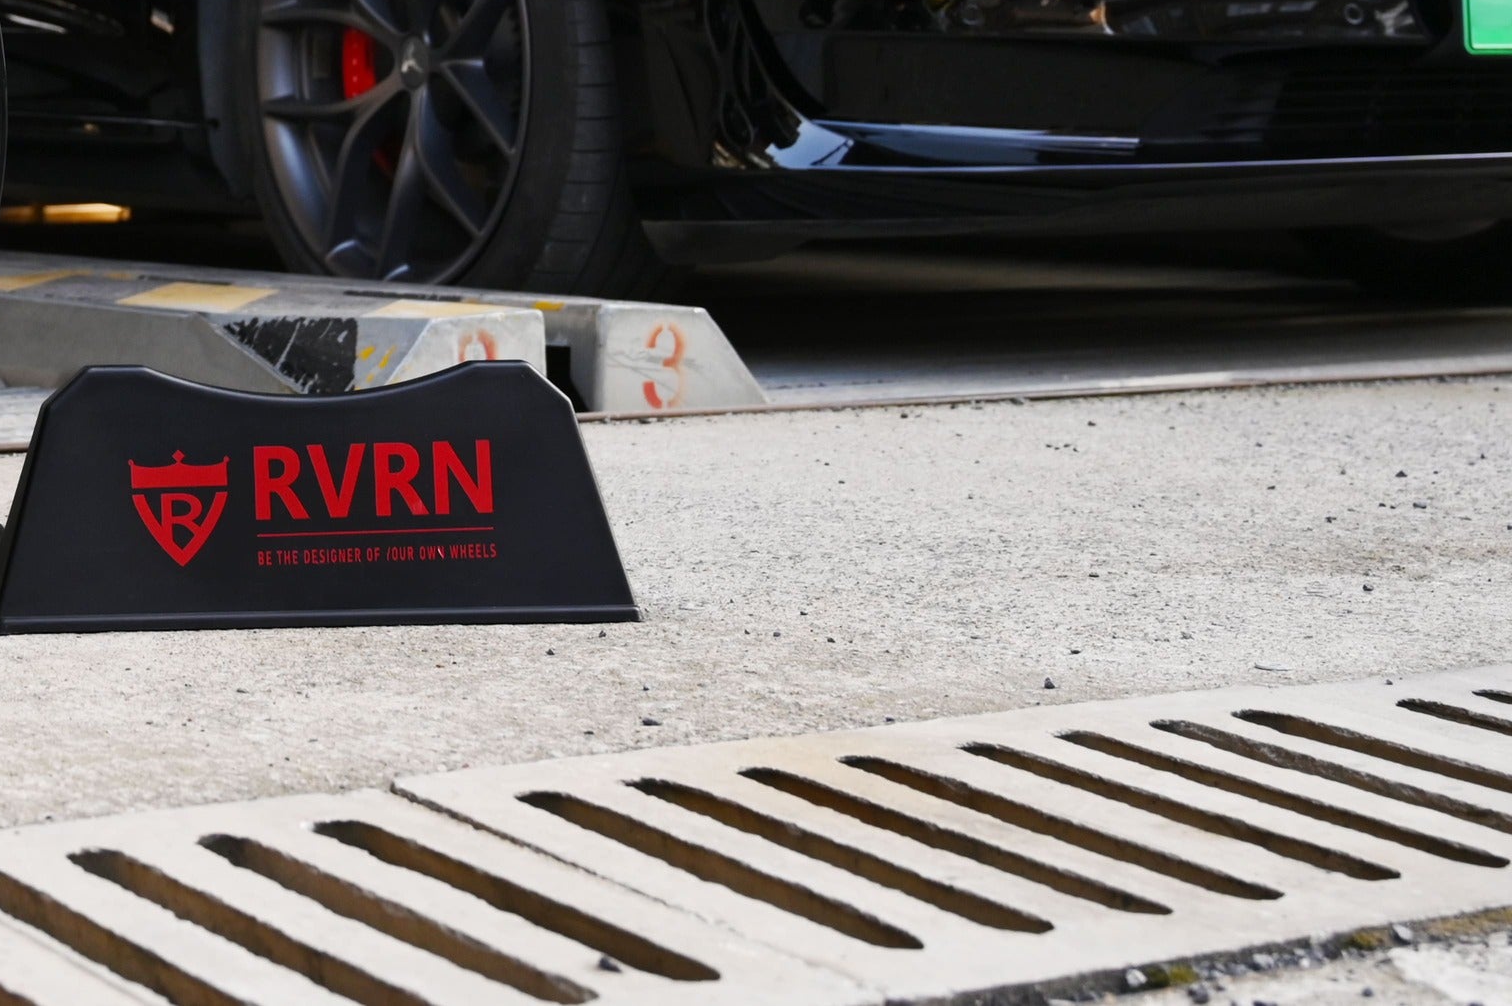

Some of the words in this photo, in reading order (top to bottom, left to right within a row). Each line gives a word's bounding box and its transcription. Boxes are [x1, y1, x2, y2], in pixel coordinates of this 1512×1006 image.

[253, 440, 494, 520] RVRN
[257, 551, 273, 566] BE
[276, 550, 299, 565] THE
[303, 548, 362, 564] DESIGNER
[366, 547, 381, 562] OF
[419, 545, 445, 560] OWN
[449, 543, 497, 559] WHEELS
